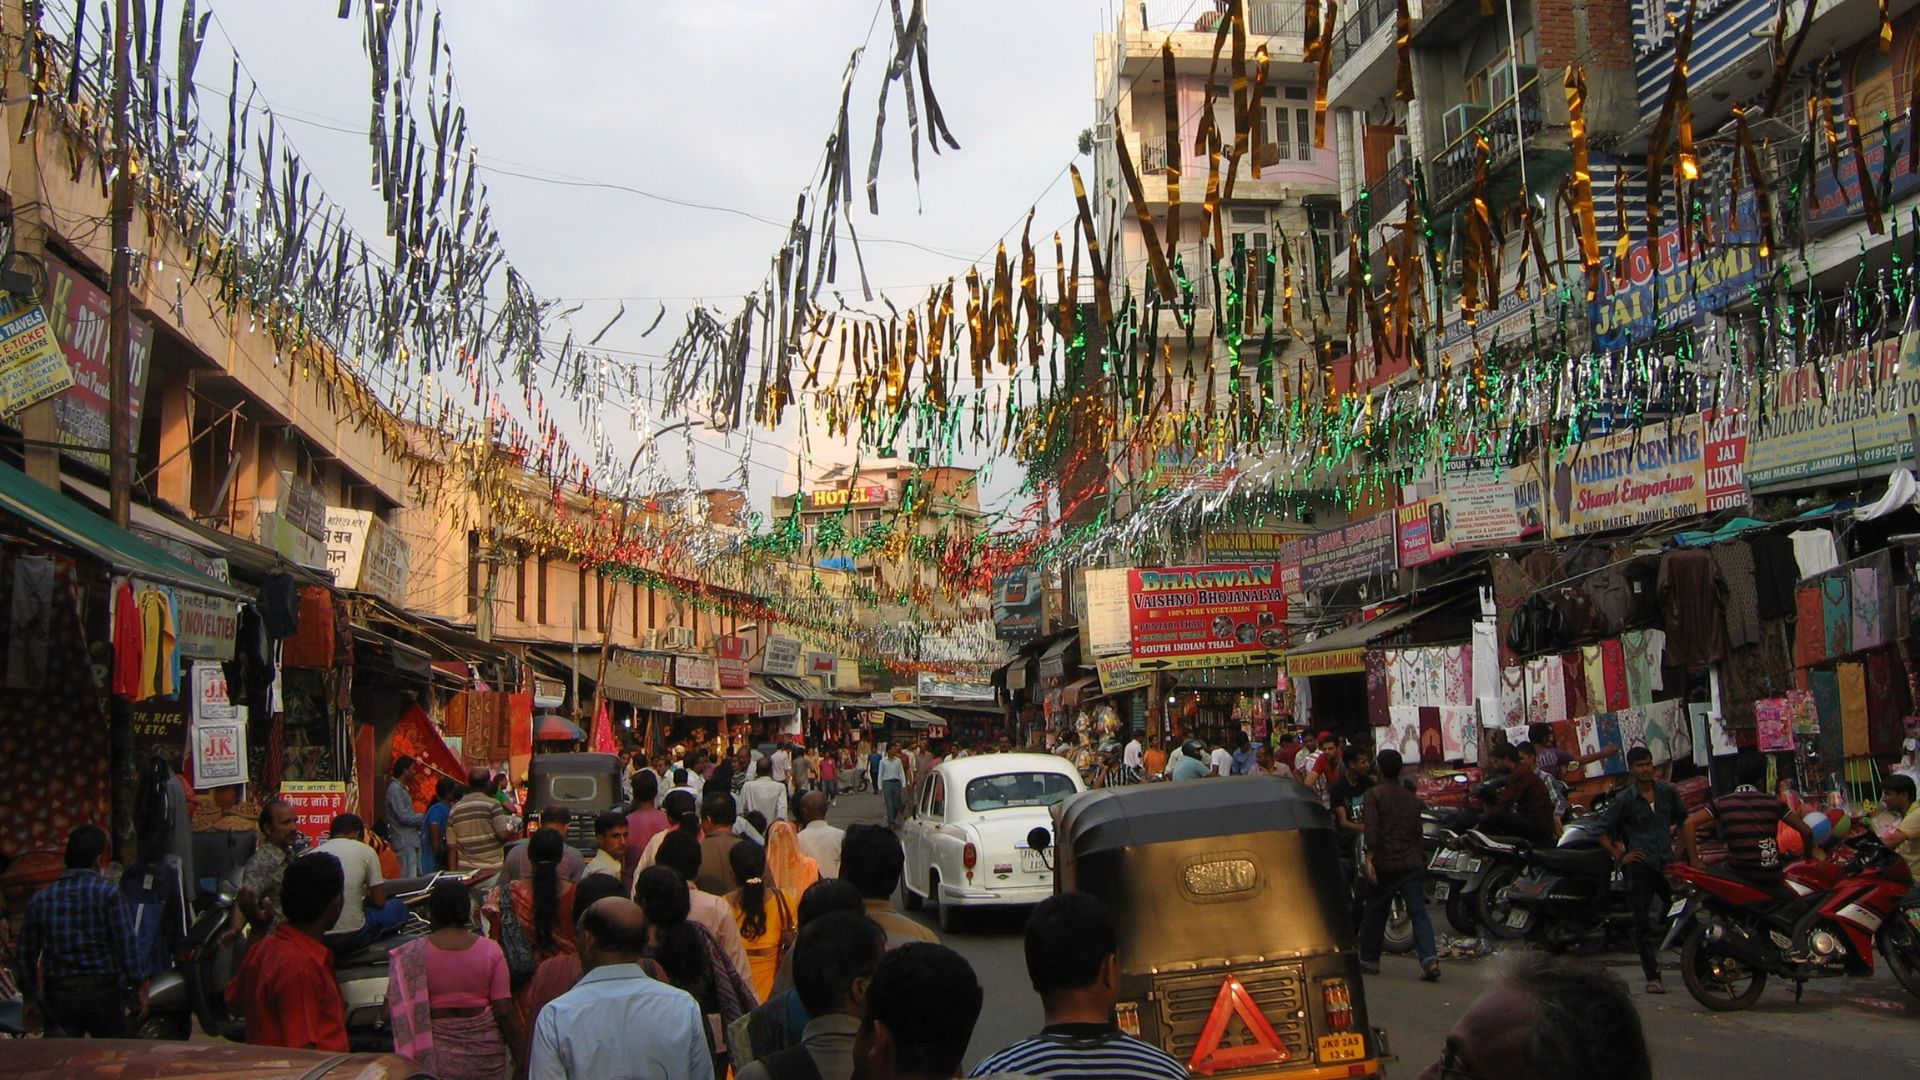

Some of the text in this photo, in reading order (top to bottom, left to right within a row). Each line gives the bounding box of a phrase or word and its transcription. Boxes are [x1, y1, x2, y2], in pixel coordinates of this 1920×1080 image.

[3, 311, 43, 336] TRAVELS
[1596, 292, 1645, 335] JAI
[1655, 302, 1697, 328] ODGE
[3, 326, 47, 353] E-TICKET
[74, 305, 105, 361] DRY
[20, 338, 48, 356] CENTRE
[25, 353, 58, 371] RAILWAY
[1476, 456, 1508, 467] TRAVLS
[1717, 444, 1737, 462] JAI
[1573, 444, 1634, 485] VARIETY
[1774, 464, 1808, 478] MARKET,
[1810, 456, 1842, 471] JAMMU
[814, 487, 870, 506] HOTEL
[1577, 472, 1696, 512] Shawl Emporium
[1399, 502, 1427, 525] HOTEL
[1583, 519, 1601, 534] HARI
[1602, 514, 1634, 530] MARKET,
[1636, 502, 1698, 525] JAMMU-180001
[1404, 537, 1426, 550] Palace
[1140, 565, 1274, 592] BHAGWAN
[1133, 587, 1283, 609] VAISHNO BHOJANALYA
[1186, 608, 1203, 616] PURE
[1206, 605, 1250, 615] VEGETARIAN
[184, 610, 236, 641] NOVELTIES
[1140, 640, 1235, 653] SOUTH INDIAN THALI
[1100, 659, 1134, 673] BHAGW
